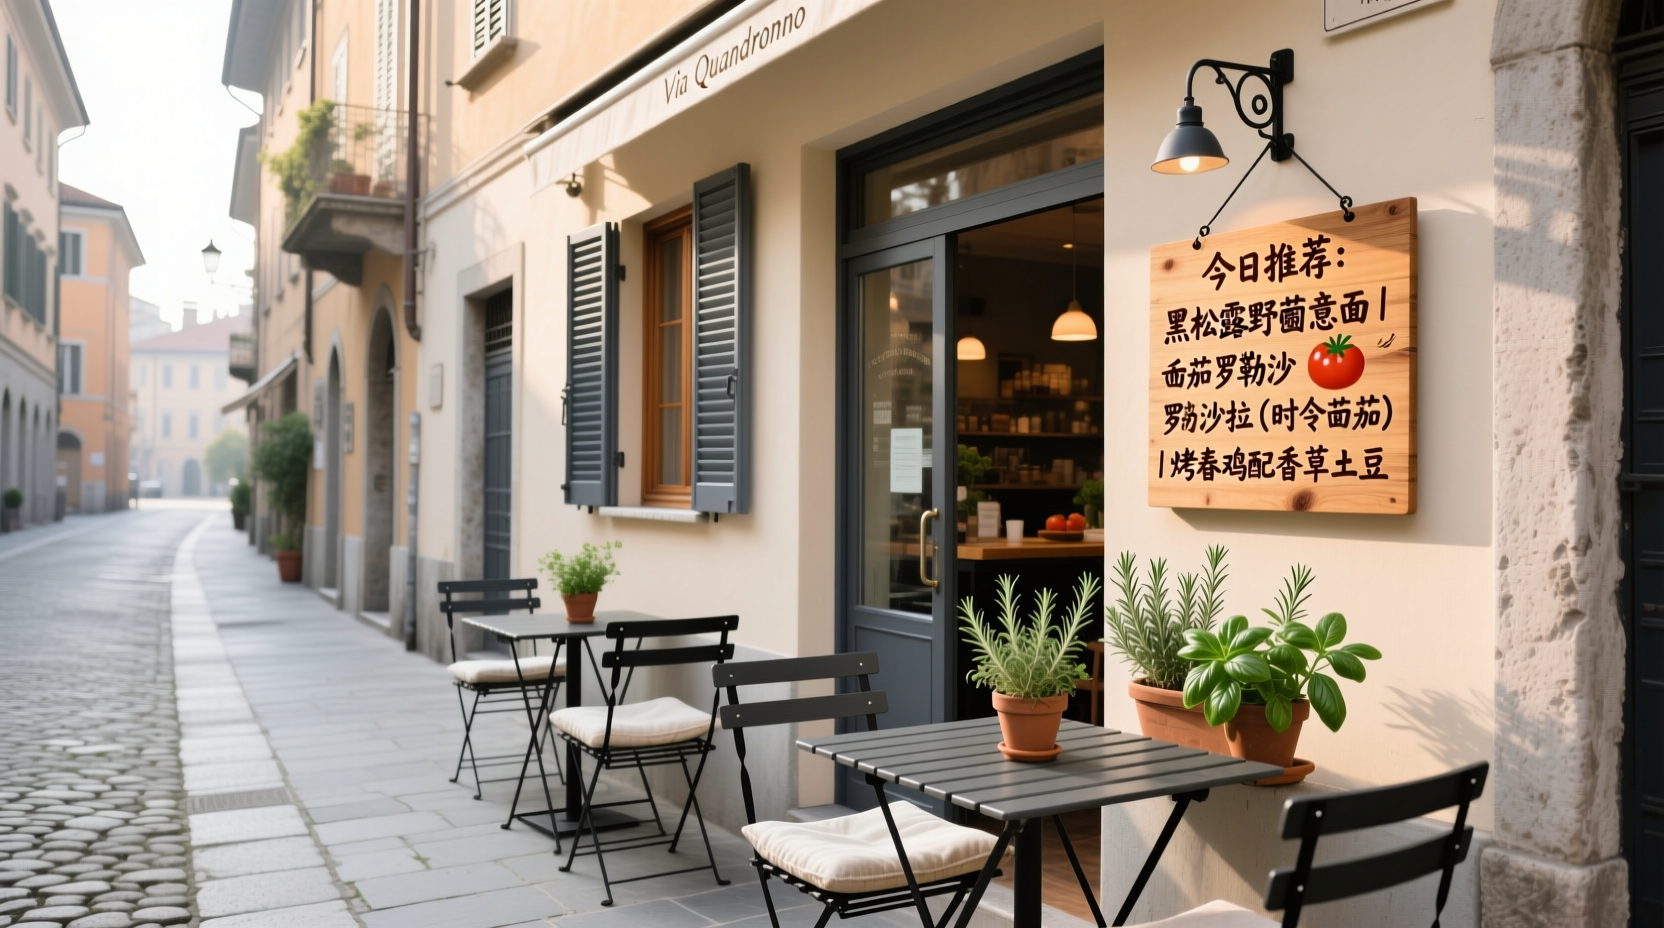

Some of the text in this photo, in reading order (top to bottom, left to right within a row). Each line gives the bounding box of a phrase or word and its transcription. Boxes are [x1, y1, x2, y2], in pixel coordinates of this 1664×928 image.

[664, 6, 806, 105] Via Quandronno
[1201, 234, 1346, 291] 今日推荐：
